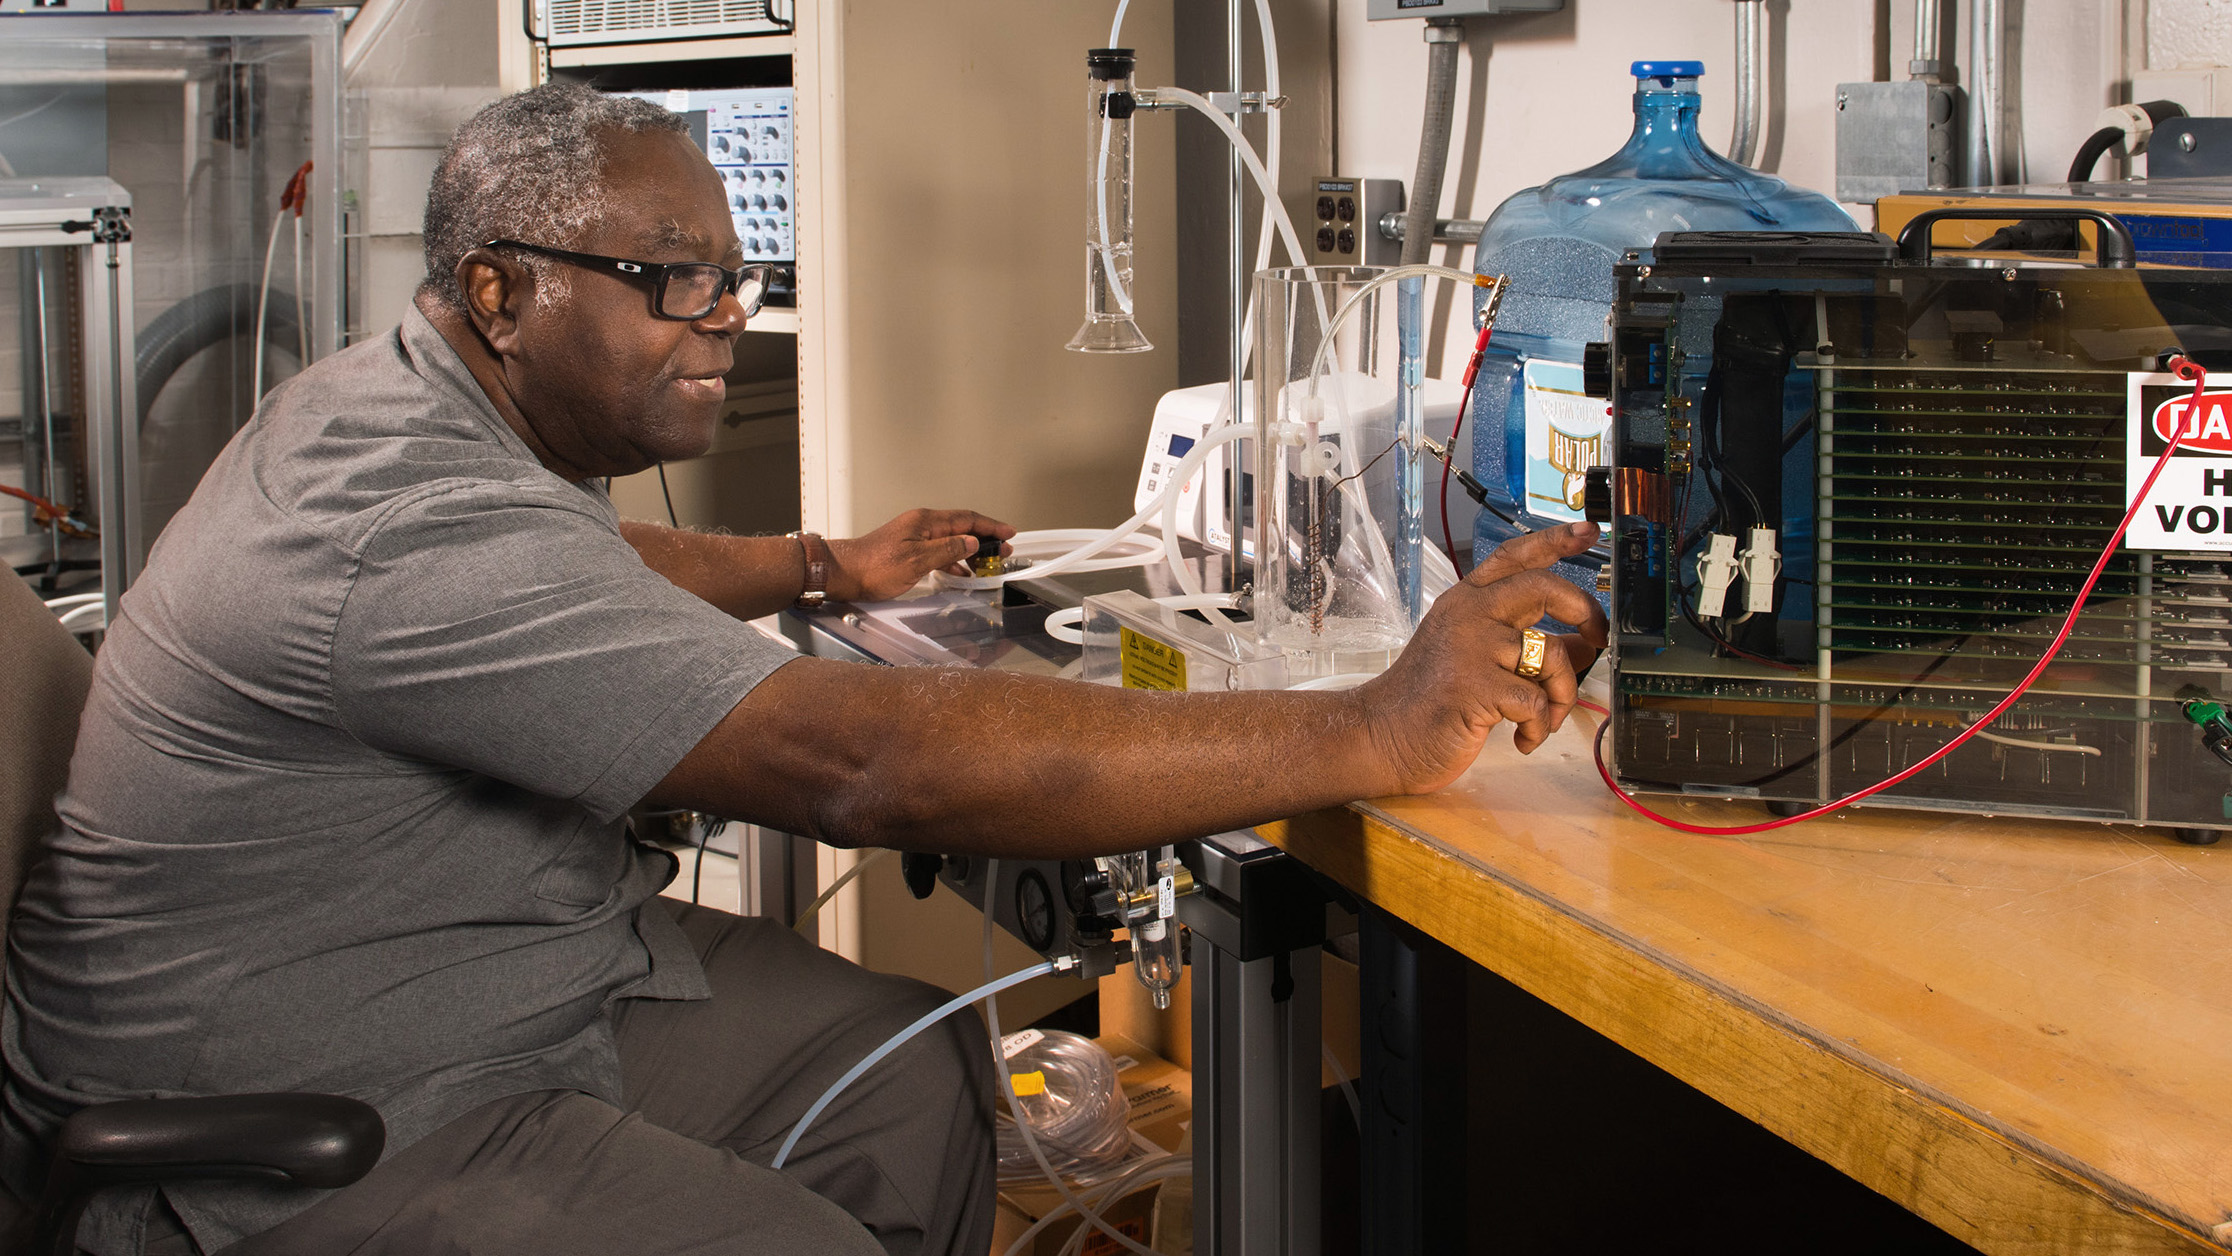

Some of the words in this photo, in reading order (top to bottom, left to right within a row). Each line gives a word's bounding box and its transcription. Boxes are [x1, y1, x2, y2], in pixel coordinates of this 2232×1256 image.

[2170, 404, 2232, 440] DA
[1554, 431, 1598, 472] POLAR
[2204, 469, 2232, 496] H
